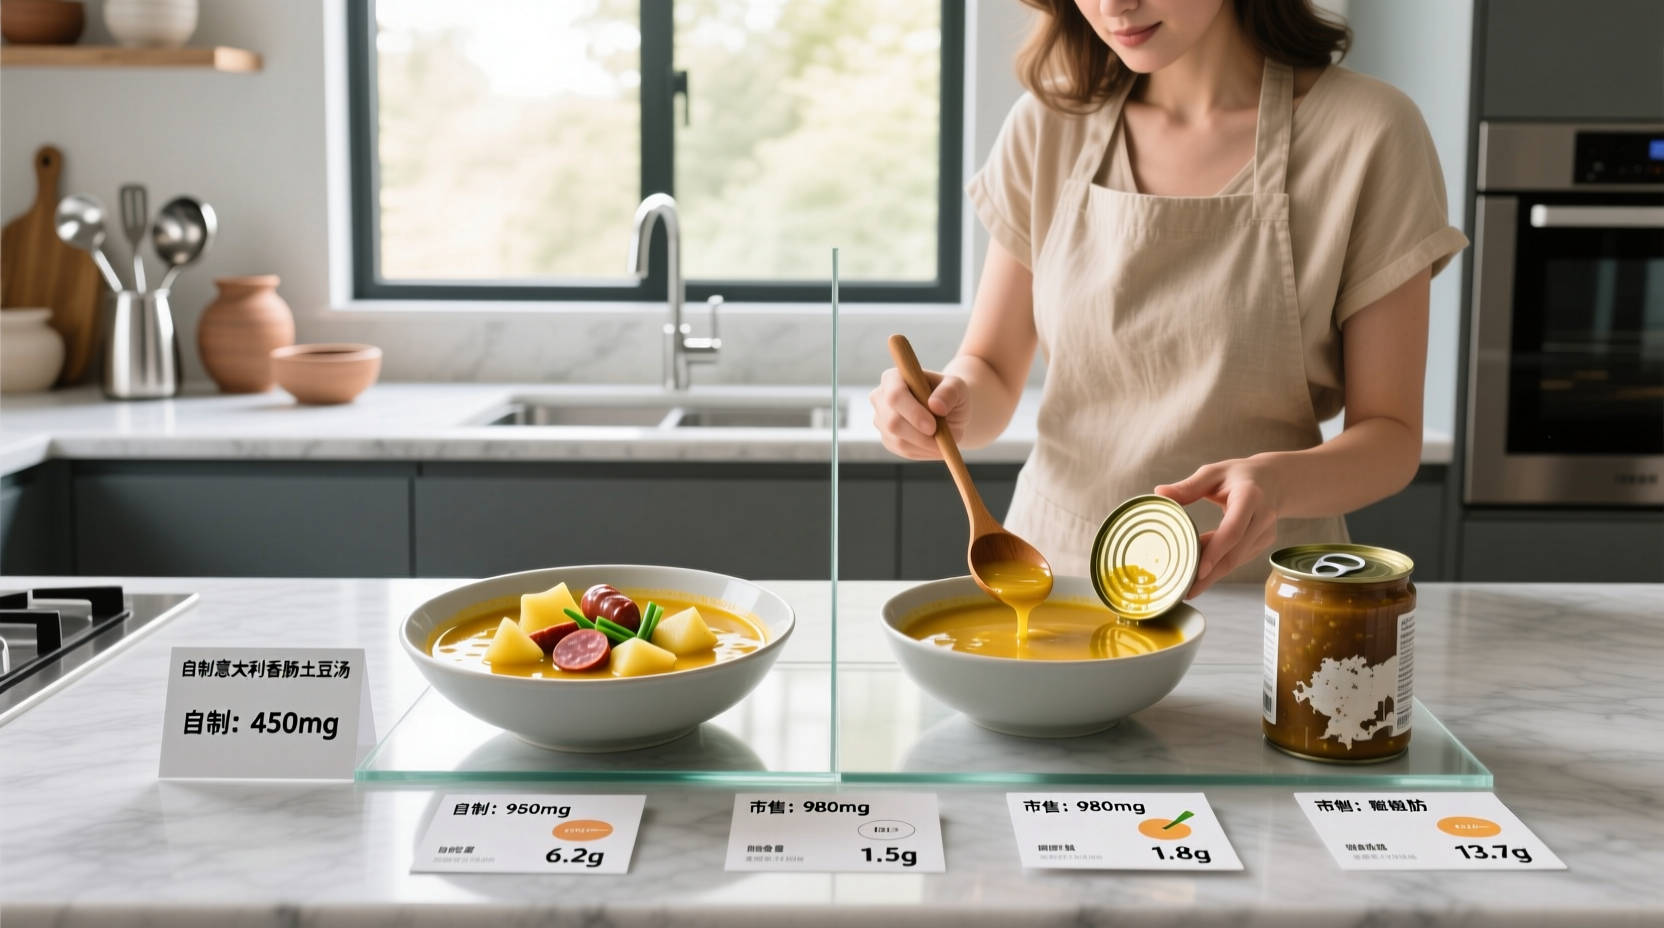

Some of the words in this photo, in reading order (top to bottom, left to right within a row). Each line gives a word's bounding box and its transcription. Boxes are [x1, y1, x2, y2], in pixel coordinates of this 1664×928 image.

[250, 712, 339, 740] 450mg
[506, 803, 571, 818] 950mg
[803, 801, 870, 816] 980mg
[1076, 801, 1146, 815] 980mg
[546, 848, 604, 867] 6.2g
[861, 847, 917, 867] 1.5g
[1152, 846, 1211, 864] 1.8g
[1455, 844, 1533, 863] 13.7g
